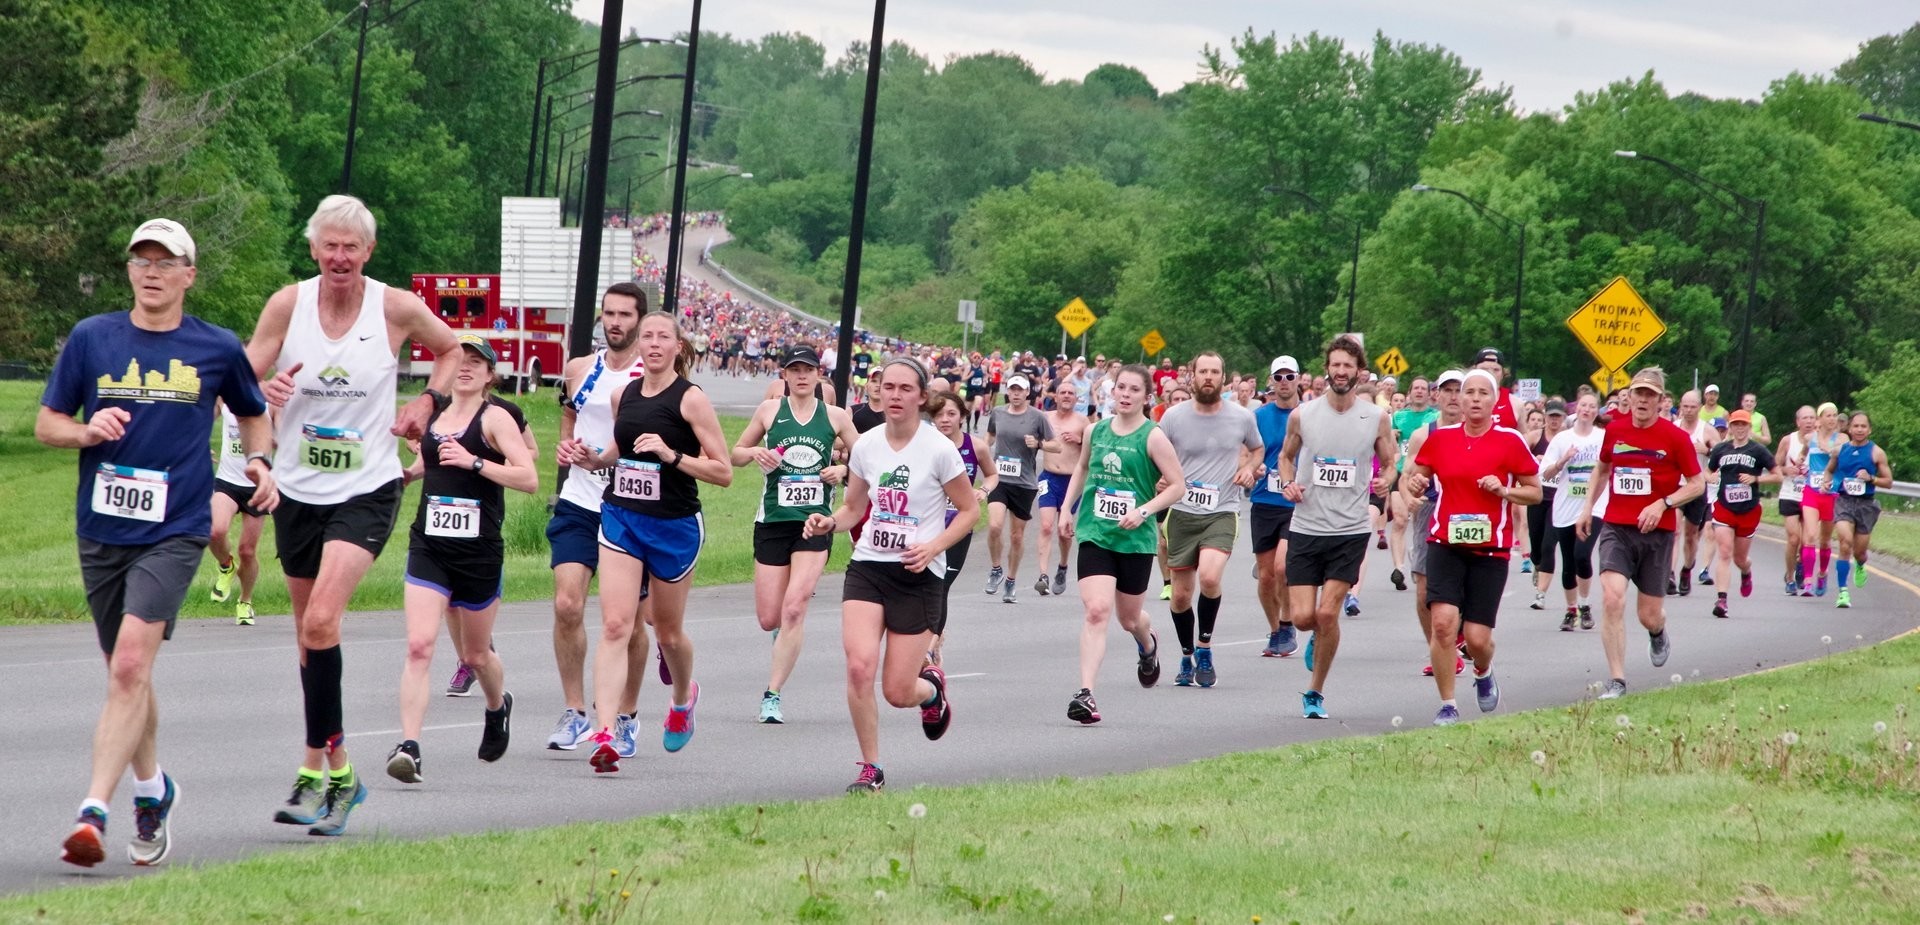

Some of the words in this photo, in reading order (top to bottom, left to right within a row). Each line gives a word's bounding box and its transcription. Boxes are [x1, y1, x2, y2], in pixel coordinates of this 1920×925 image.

[1592, 304, 1615, 314] TWO
[1619, 306, 1645, 317] WAY
[1594, 319, 1641, 332] TRAFFIC
[1596, 335, 1636, 346] AHEAD
[301, 388, 324, 398] GREEN
[325, 390, 367, 398] MOUNTAIN
[777, 436, 797, 448] NEW
[799, 436, 826, 452] HAVEN
[308, 446, 351, 469] 5671
[793, 464, 823, 476] RUNNERS
[999, 463, 1017, 473] 1486
[1319, 468, 1349, 482] 2074
[619, 476, 653, 497] 6436
[1619, 478, 1644, 490] 1870
[104, 485, 154, 512] 1908
[785, 487, 818, 501] 2337
[1188, 490, 1213, 506] 2101
[1728, 490, 1750, 500] 6563
[1099, 499, 1128, 516] 2163
[432, 510, 470, 530] 3201
[873, 529, 907, 550] 6874
[1455, 527, 1485, 540] 5421
